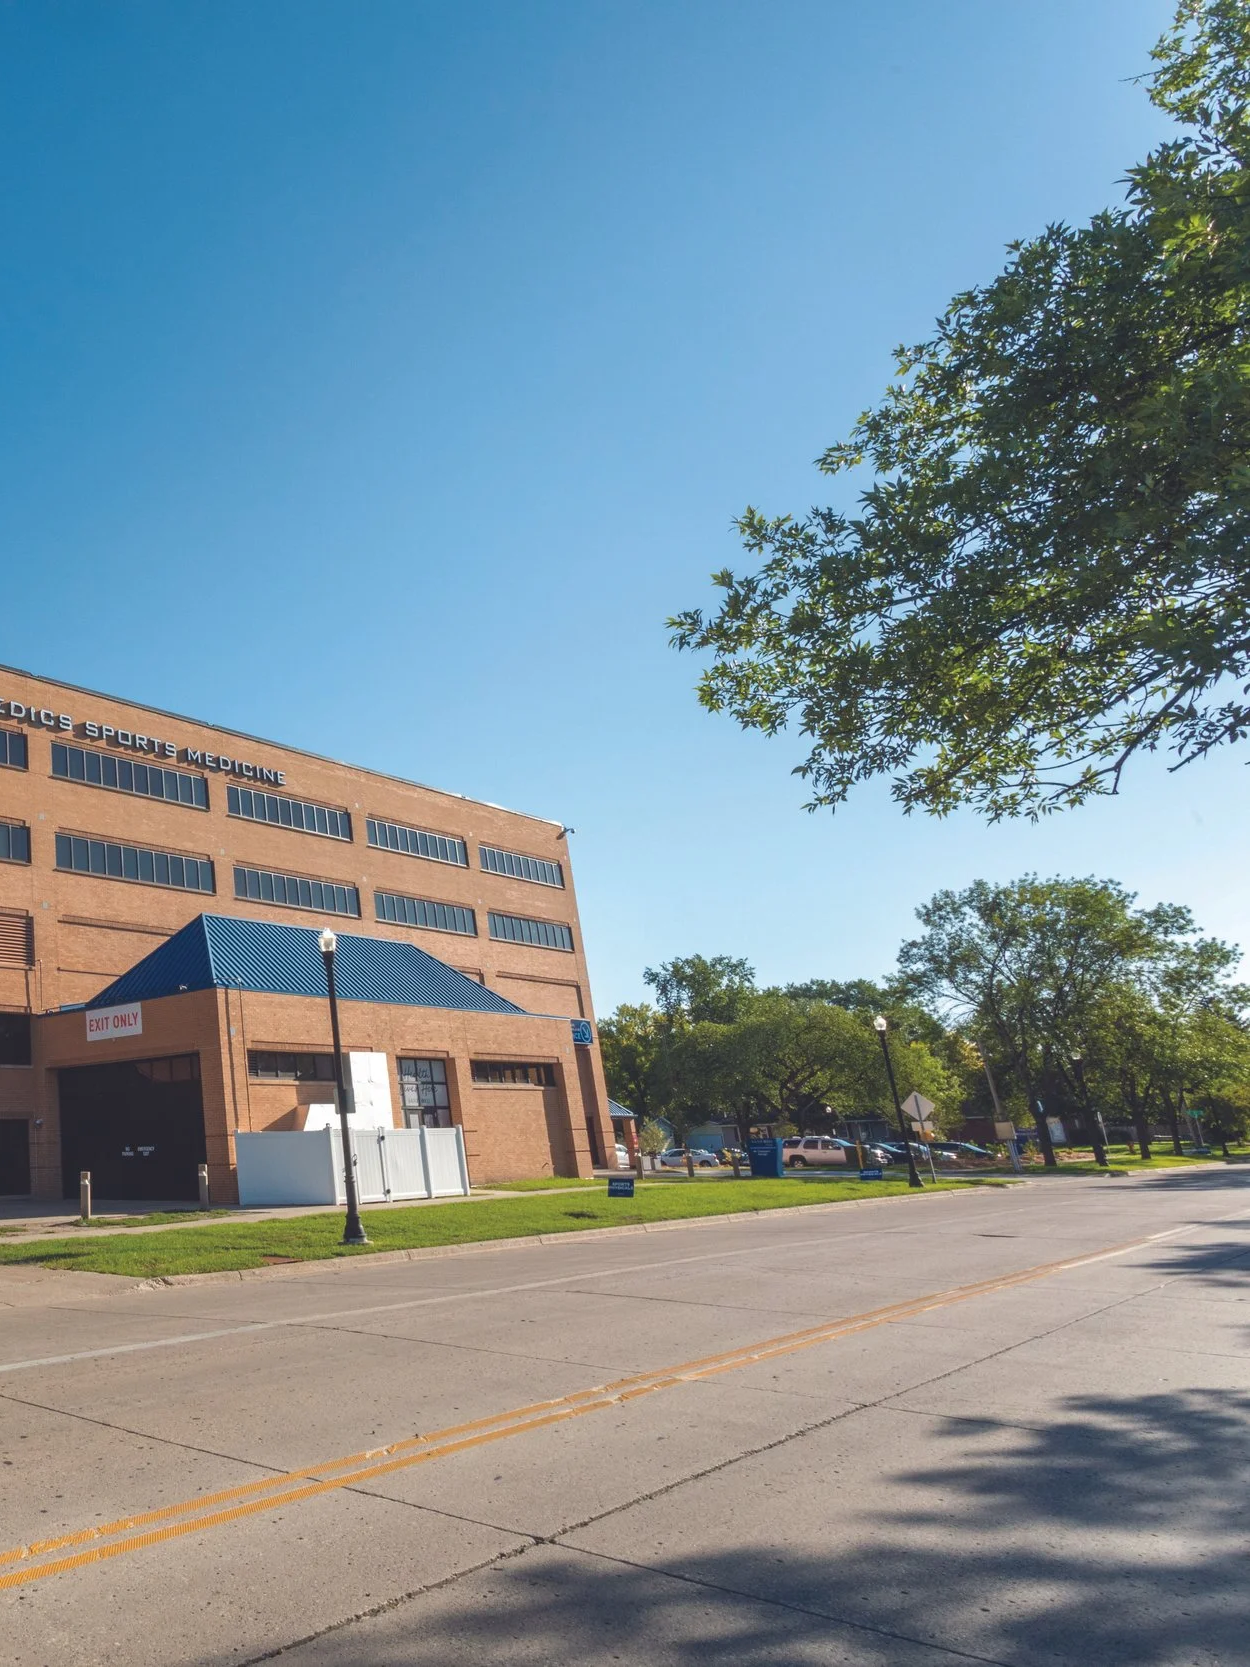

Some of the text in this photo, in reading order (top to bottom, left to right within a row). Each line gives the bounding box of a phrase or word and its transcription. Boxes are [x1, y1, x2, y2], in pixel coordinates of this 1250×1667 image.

[85, 720, 177, 757] SPORTS
[187, 747, 287, 785] MEDICINE
[89, 1012, 138, 1032] EXIT ONLY
